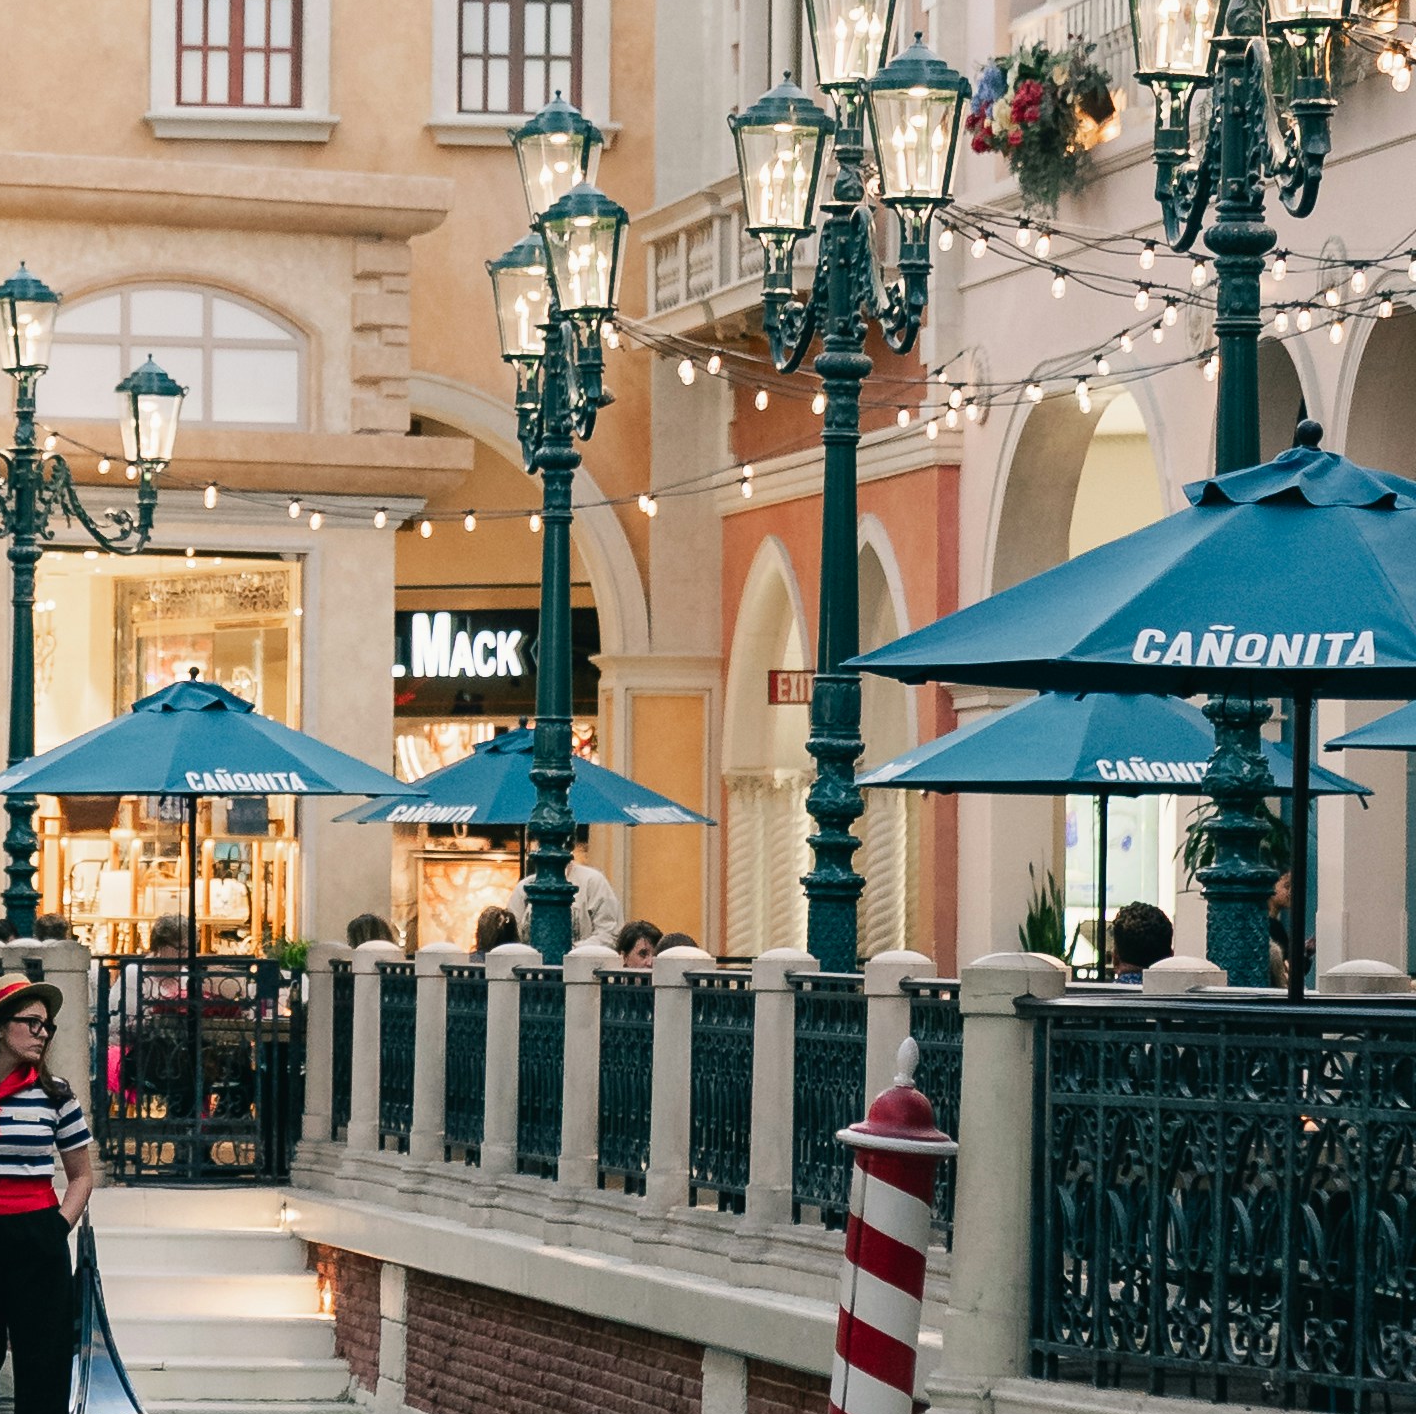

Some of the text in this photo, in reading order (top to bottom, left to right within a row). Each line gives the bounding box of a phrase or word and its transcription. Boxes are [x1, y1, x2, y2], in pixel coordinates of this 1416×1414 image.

[1132, 624, 1376, 667] CAÑONITA
[185, 768, 308, 792] CAÑONITA
[386, 801, 478, 823] CAÑONITA
